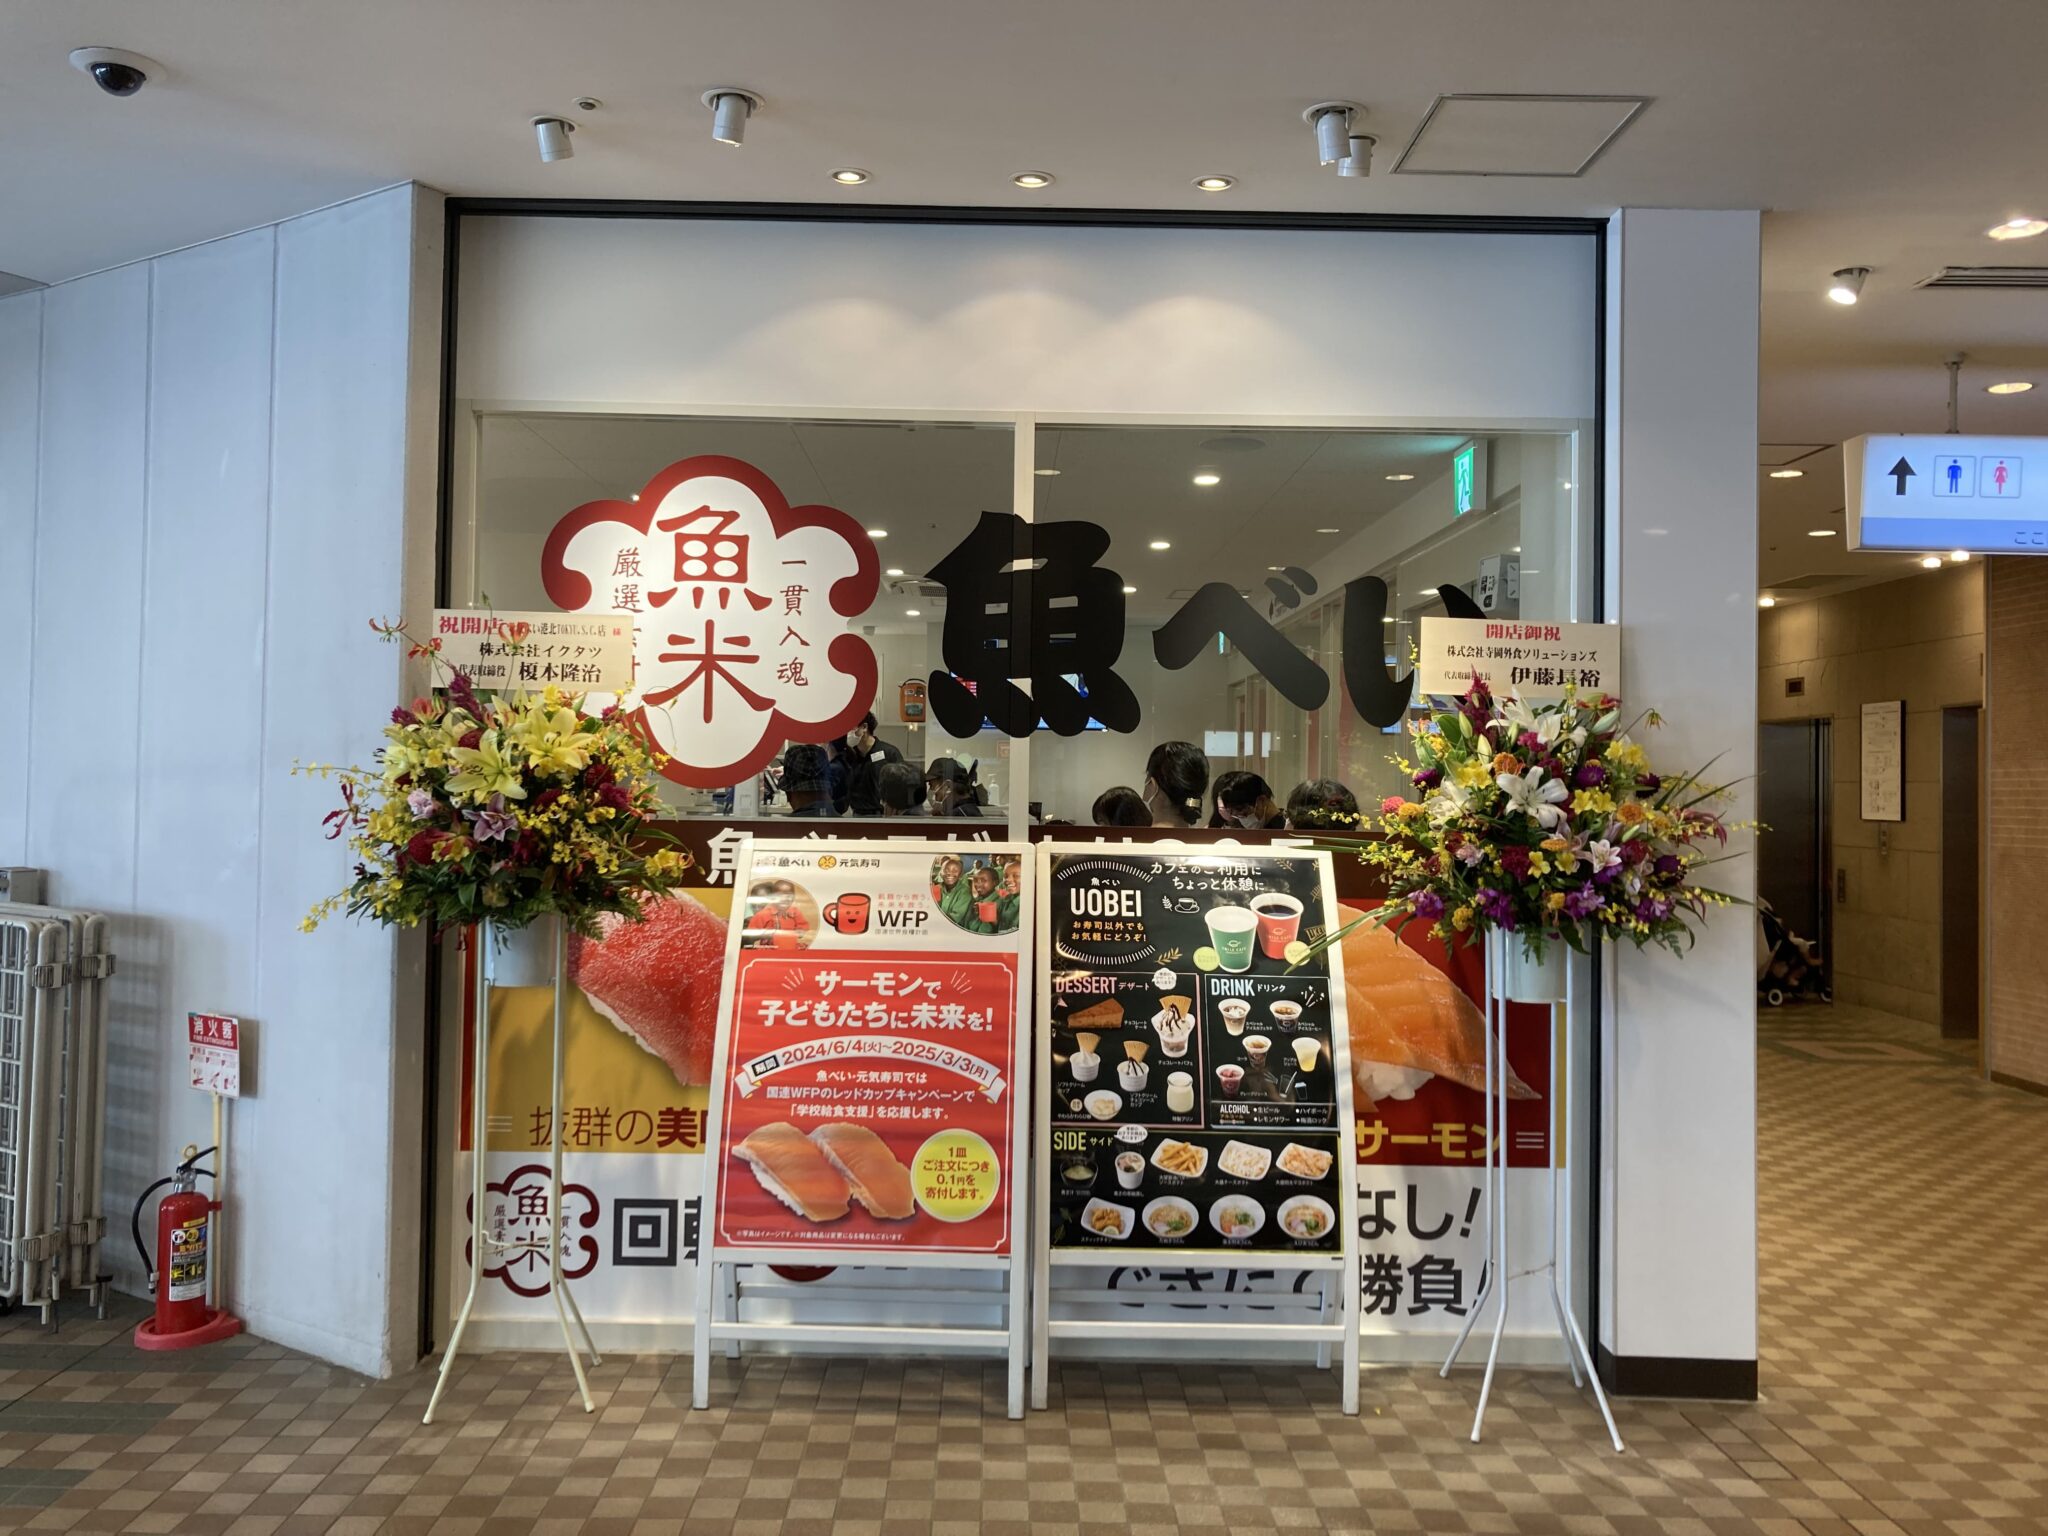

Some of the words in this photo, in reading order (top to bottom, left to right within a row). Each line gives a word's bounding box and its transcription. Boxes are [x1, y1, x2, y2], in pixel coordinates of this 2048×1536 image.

[438, 615, 503, 635] 祝開店
[777, 559, 810, 687] 一貫入魂
[924, 511, 1492, 738] 魚べい
[1486, 624, 1561, 641] 開店御祝
[478, 642, 603, 658] 株式会社イクタツ
[518, 661, 601, 683] 榎本隆治
[1510, 666, 1600, 688] 伊藤長裕
[838, 857, 880, 868] 元気寿司
[1090, 877, 1121, 887] 魚べい
[1172, 876, 1265, 891] ちょっと休憩に
[1070, 888, 1142, 917] UOBEI
[877, 910, 929, 928] WFP
[1073, 921, 1144, 932] お寿司以外でも
[814, 970, 942, 999] サーモンで
[1055, 976, 1118, 994] DESSERT
[1118, 982, 1150, 991] デザート
[1210, 978, 1256, 997] DRINK
[1257, 983, 1286, 993] ドリンク
[193, 1017, 233, 1040] 消火器
[815, 1070, 927, 1083] 魚べい・元気寿司では
[766, 1087, 975, 1103] 国連WFPのレッドカップキャンペーンで
[790, 1104, 949, 1120] 「学校給食支援」を応援します。
[1219, 1104, 1250, 1114] ALCOHOL
[529, 1106, 709, 1149] 抜群の美
[1053, 1131, 1087, 1151] SIDE
[1089, 1137, 1114, 1147] サイド
[948, 1147, 967, 1158] 1皿
[923, 1160, 989, 1172] ご注文につき
[936, 1174, 976, 1186] 0.1円を
[925, 1187, 984, 1200] 寄付します。
